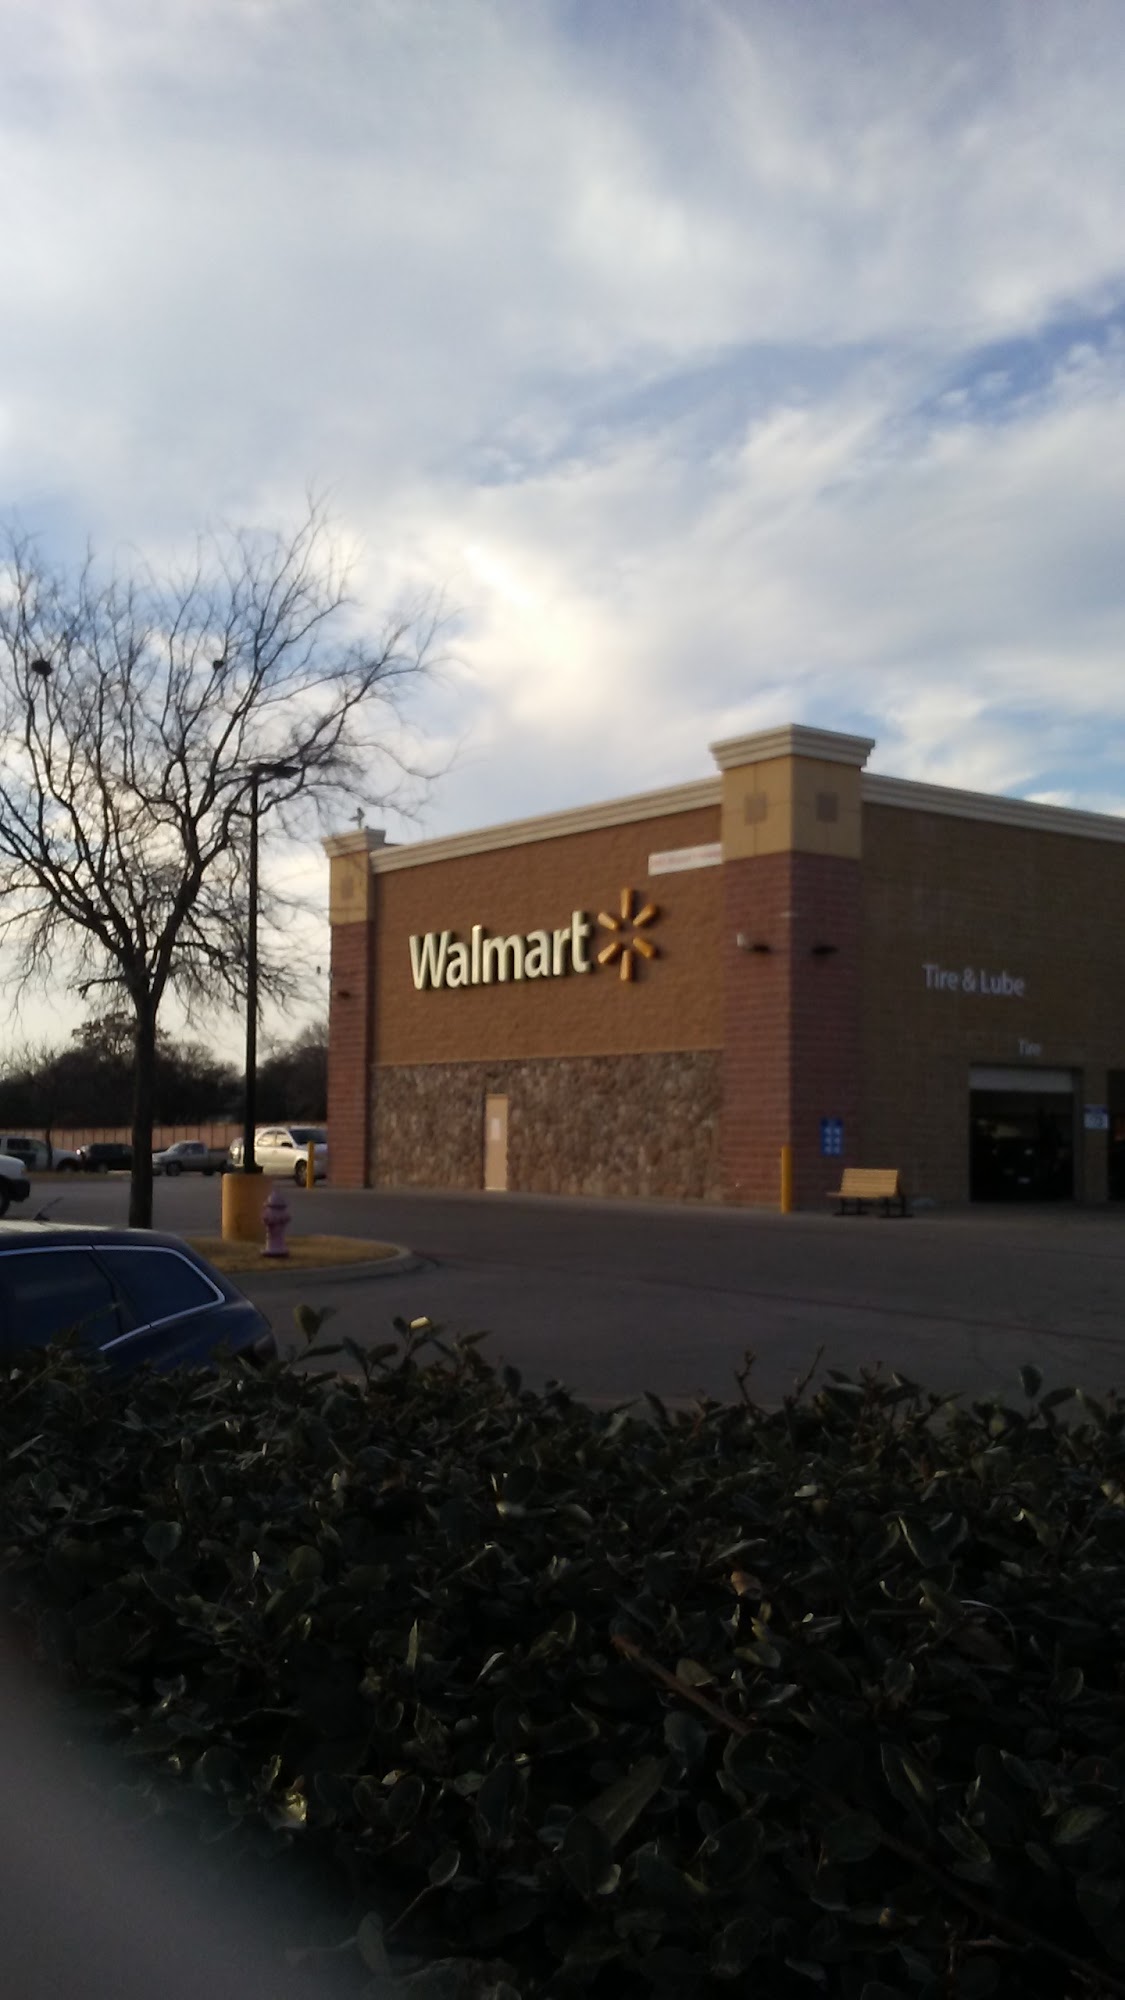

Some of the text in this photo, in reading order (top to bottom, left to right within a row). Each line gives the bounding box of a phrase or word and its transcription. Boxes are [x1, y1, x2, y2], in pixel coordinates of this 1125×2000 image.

[409, 910, 590, 990] Walmart
[922, 963, 1026, 996] Tire & Lube
